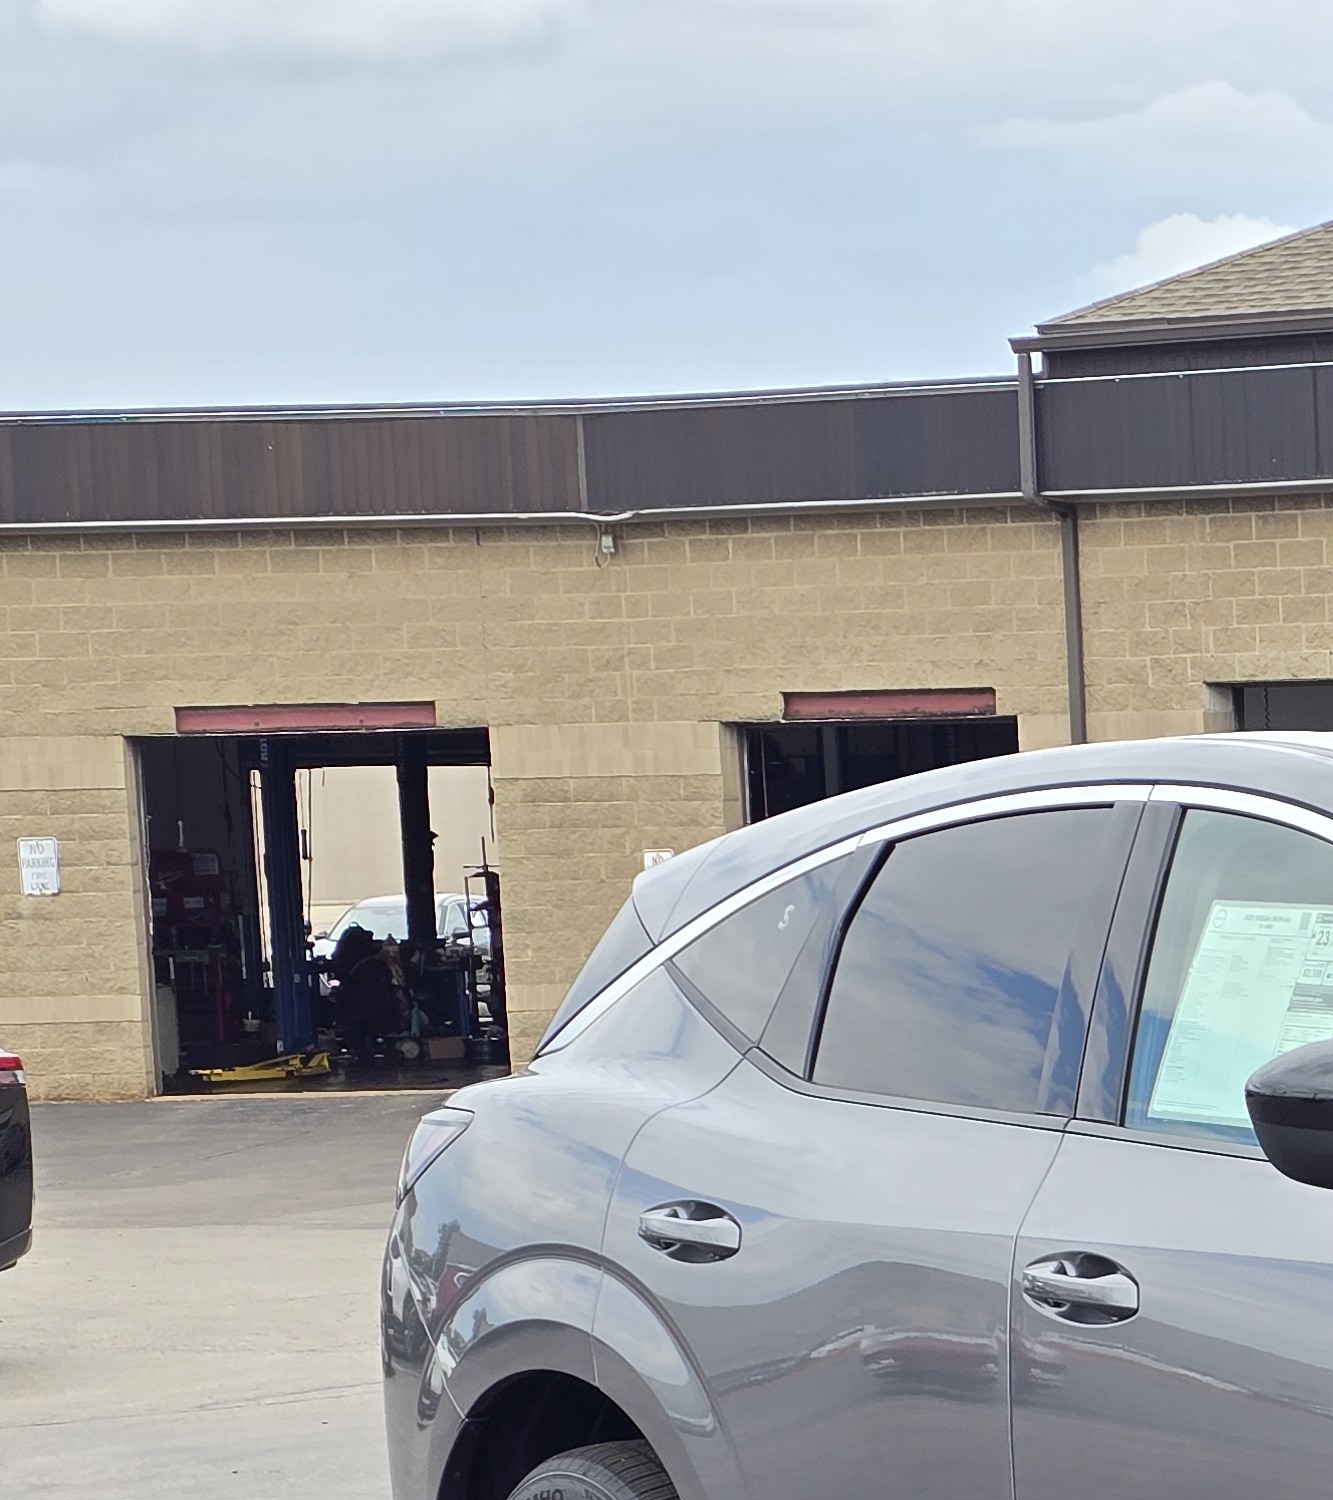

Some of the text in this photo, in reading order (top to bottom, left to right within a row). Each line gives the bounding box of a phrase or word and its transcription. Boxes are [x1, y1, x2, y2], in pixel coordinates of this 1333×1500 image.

[29, 843, 45, 855] NO
[22, 856, 55, 869] PARKING
[1315, 930, 1331, 947] 23
